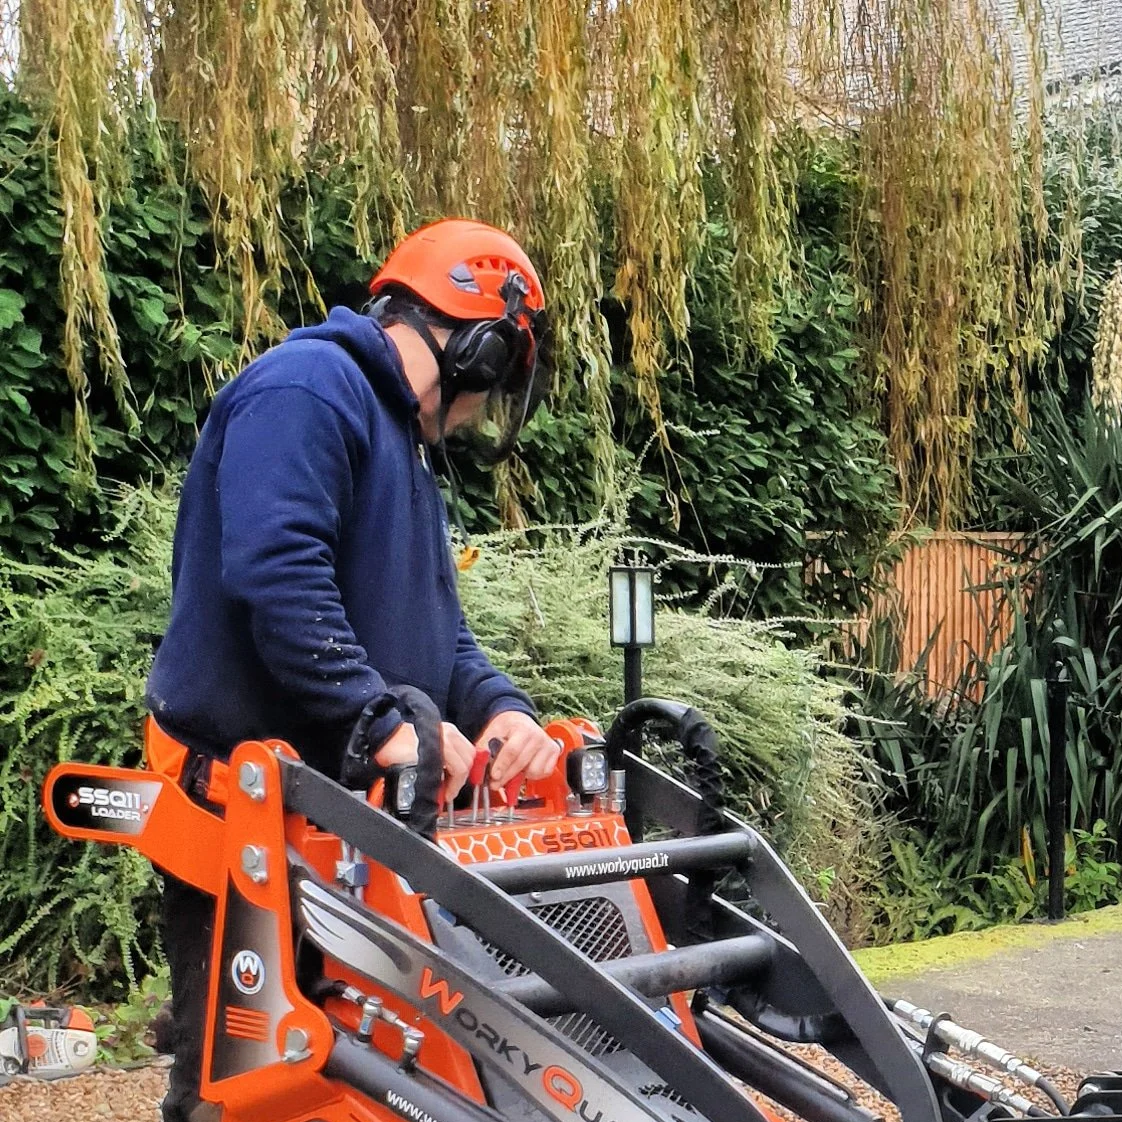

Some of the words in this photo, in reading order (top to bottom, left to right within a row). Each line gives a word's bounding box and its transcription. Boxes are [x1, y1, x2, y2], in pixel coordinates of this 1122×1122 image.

[78, 787, 140, 809] SSQ11
[91, 806, 141, 821] LOADER
[542, 829, 612, 853] SSQ11
[565, 852, 669, 878] www.workyquad.it
